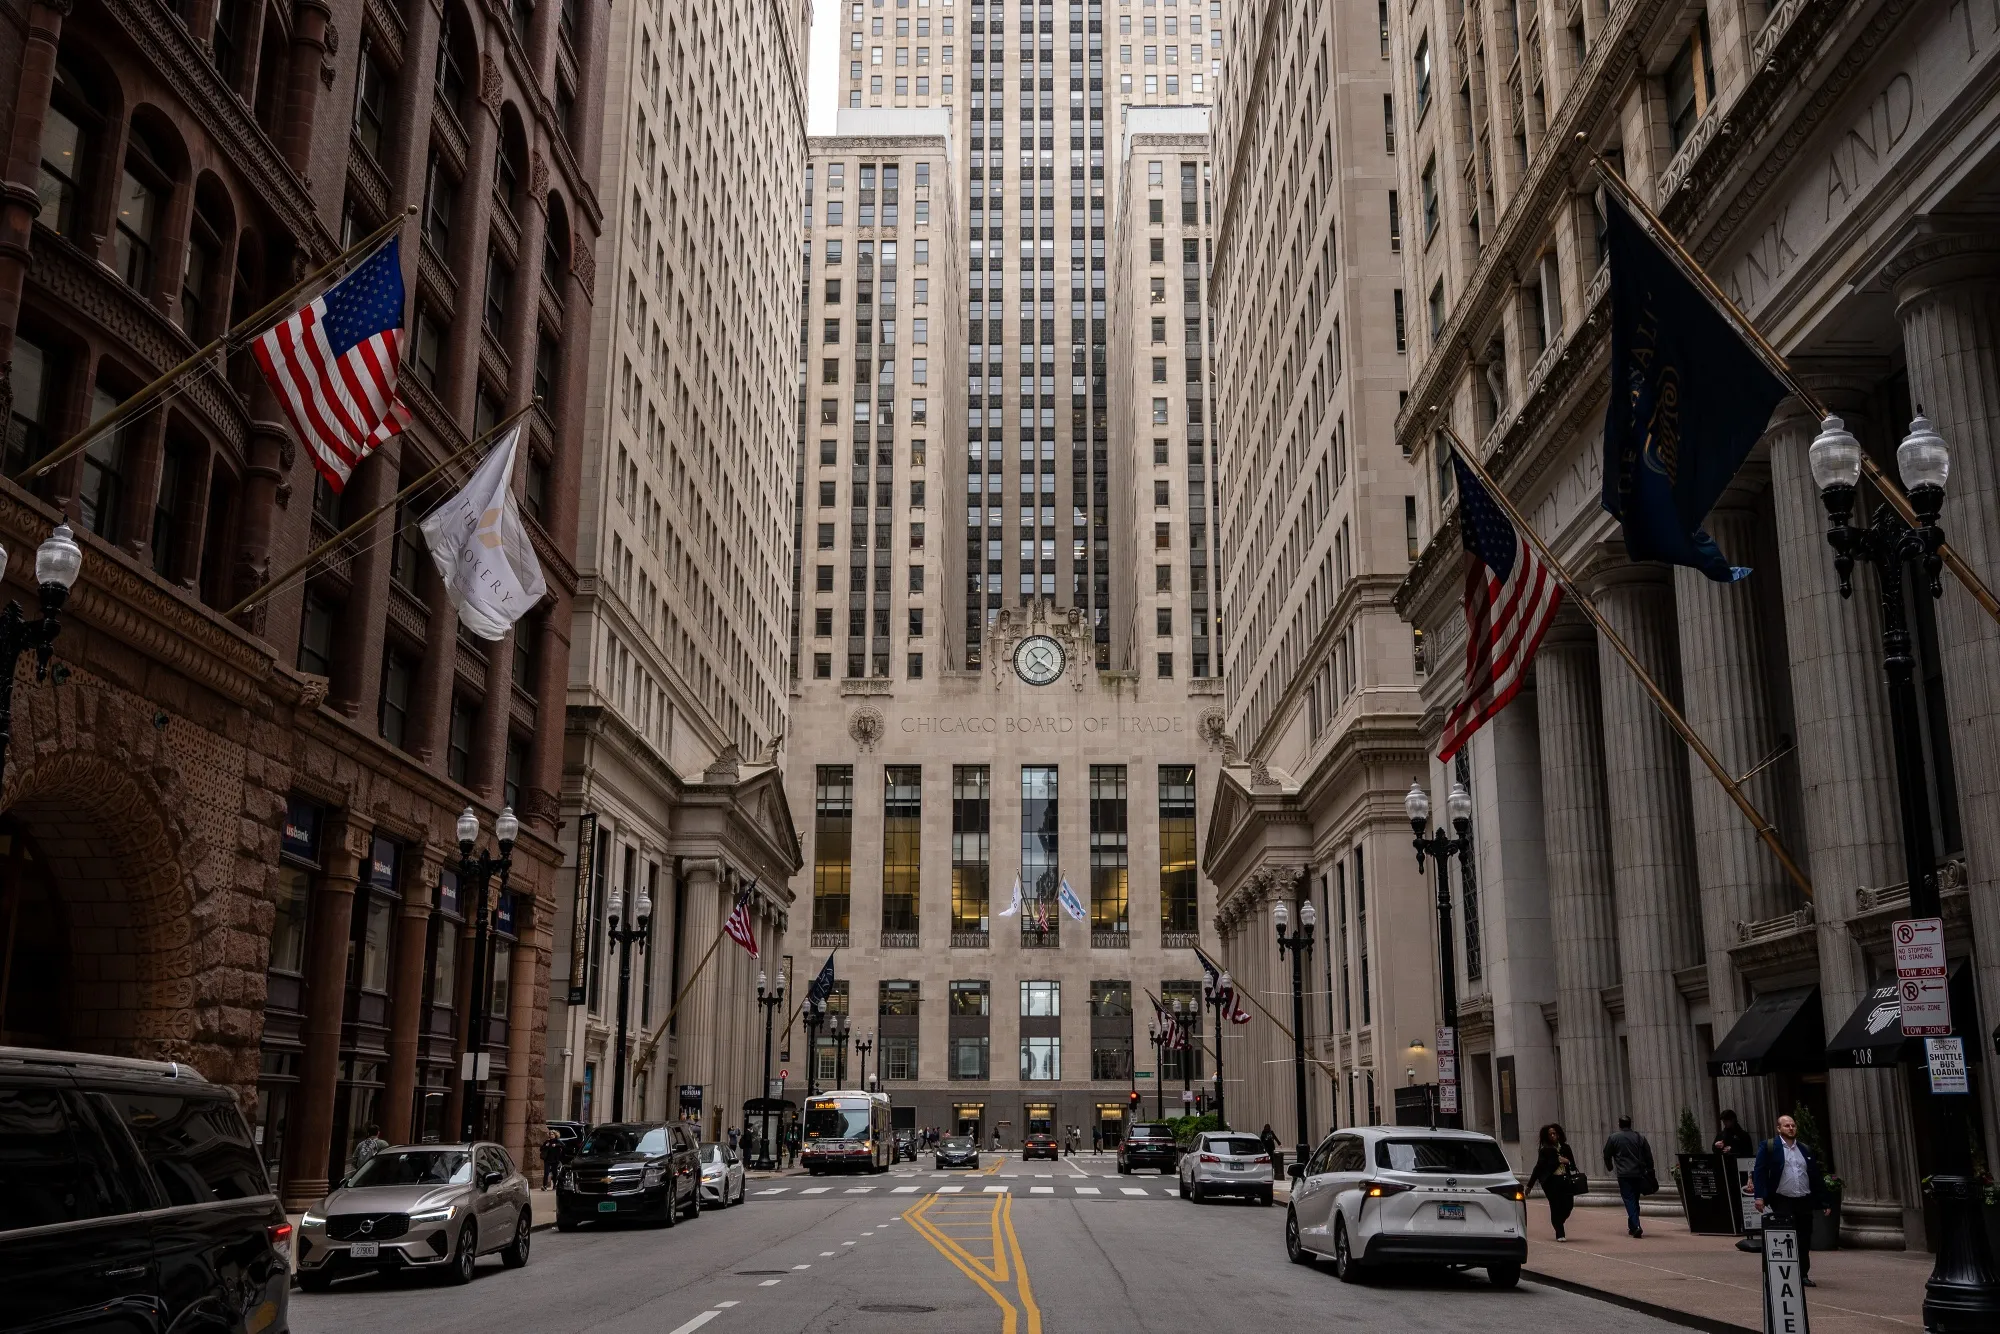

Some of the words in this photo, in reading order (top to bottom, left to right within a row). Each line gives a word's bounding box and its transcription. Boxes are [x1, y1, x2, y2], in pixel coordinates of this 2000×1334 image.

[1730, 203, 1799, 316] ANK
[1825, 71, 1914, 224] AND
[460, 498, 477, 528] TH
[464, 549, 513, 603] OKERY
[901, 717, 997, 733] CHICAGO
[1005, 717, 1073, 733] BOARD
[1083, 717, 1109, 733] OF
[1120, 717, 1184, 733] TRADE
[286, 823, 309, 843] usbank
[1900, 969, 1917, 977] TOW
[1921, 968, 1942, 976] ZONE
[1872, 986, 1896, 999] THE
[1903, 1004, 1926, 1012] LOADING
[1905, 1026, 1922, 1035] TOW
[1926, 1026, 1947, 1034] ZONE
[1853, 1048, 1872, 1065] 208
[1930, 1053, 1962, 1061] SHUTTLE
[1932, 1068, 1965, 1076] LOADING
[1778, 1265, 1796, 1334] VALE
